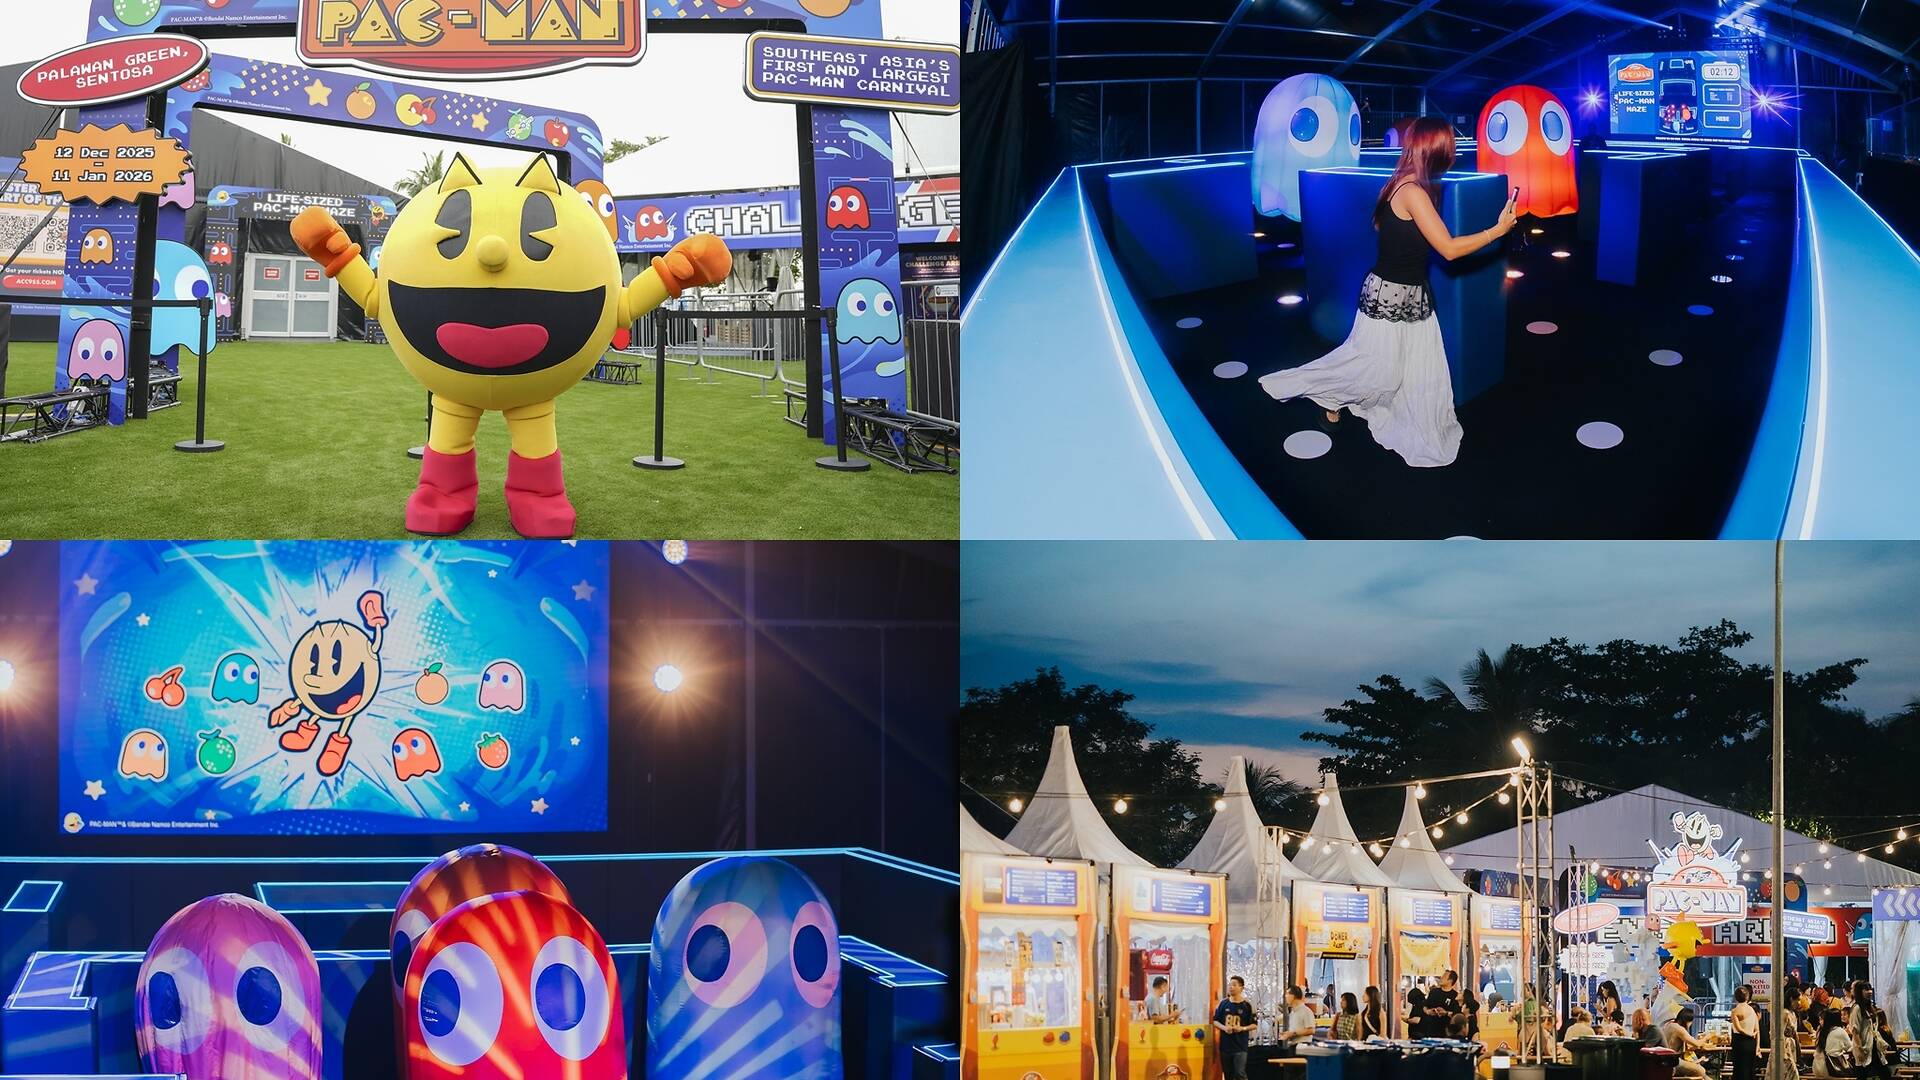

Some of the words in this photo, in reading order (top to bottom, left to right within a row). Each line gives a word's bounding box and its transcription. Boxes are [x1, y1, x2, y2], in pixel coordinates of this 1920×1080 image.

[37, 58, 113, 82] PALAWAN
[125, 46, 189, 64] GREEN,
[762, 46, 868, 65] SOUTHEAST
[880, 55, 950, 70] ASIA'S
[76, 65, 154, 88] SENTOSA
[762, 59, 815, 74] FIRST
[825, 64, 860, 78] AND
[872, 68, 950, 84] LARGEST
[1710, 68, 1734, 76] 02:12
[762, 72, 845, 88] PAC-MAN
[856, 79, 950, 97] CARNIVAL
[55, 148, 72, 158] 12
[80, 148, 109, 158] Dec
[116, 148, 154, 158] 2025
[52, 170, 70, 182] 11
[78, 170, 106, 182] Jan
[114, 170, 153, 182] 2026
[24, 194, 42, 204] OF
[45, 195, 70, 206] TH
[267, 193, 343, 206] LIFE-SIZED
[1652, 889, 1742, 913] PAC-MAN
